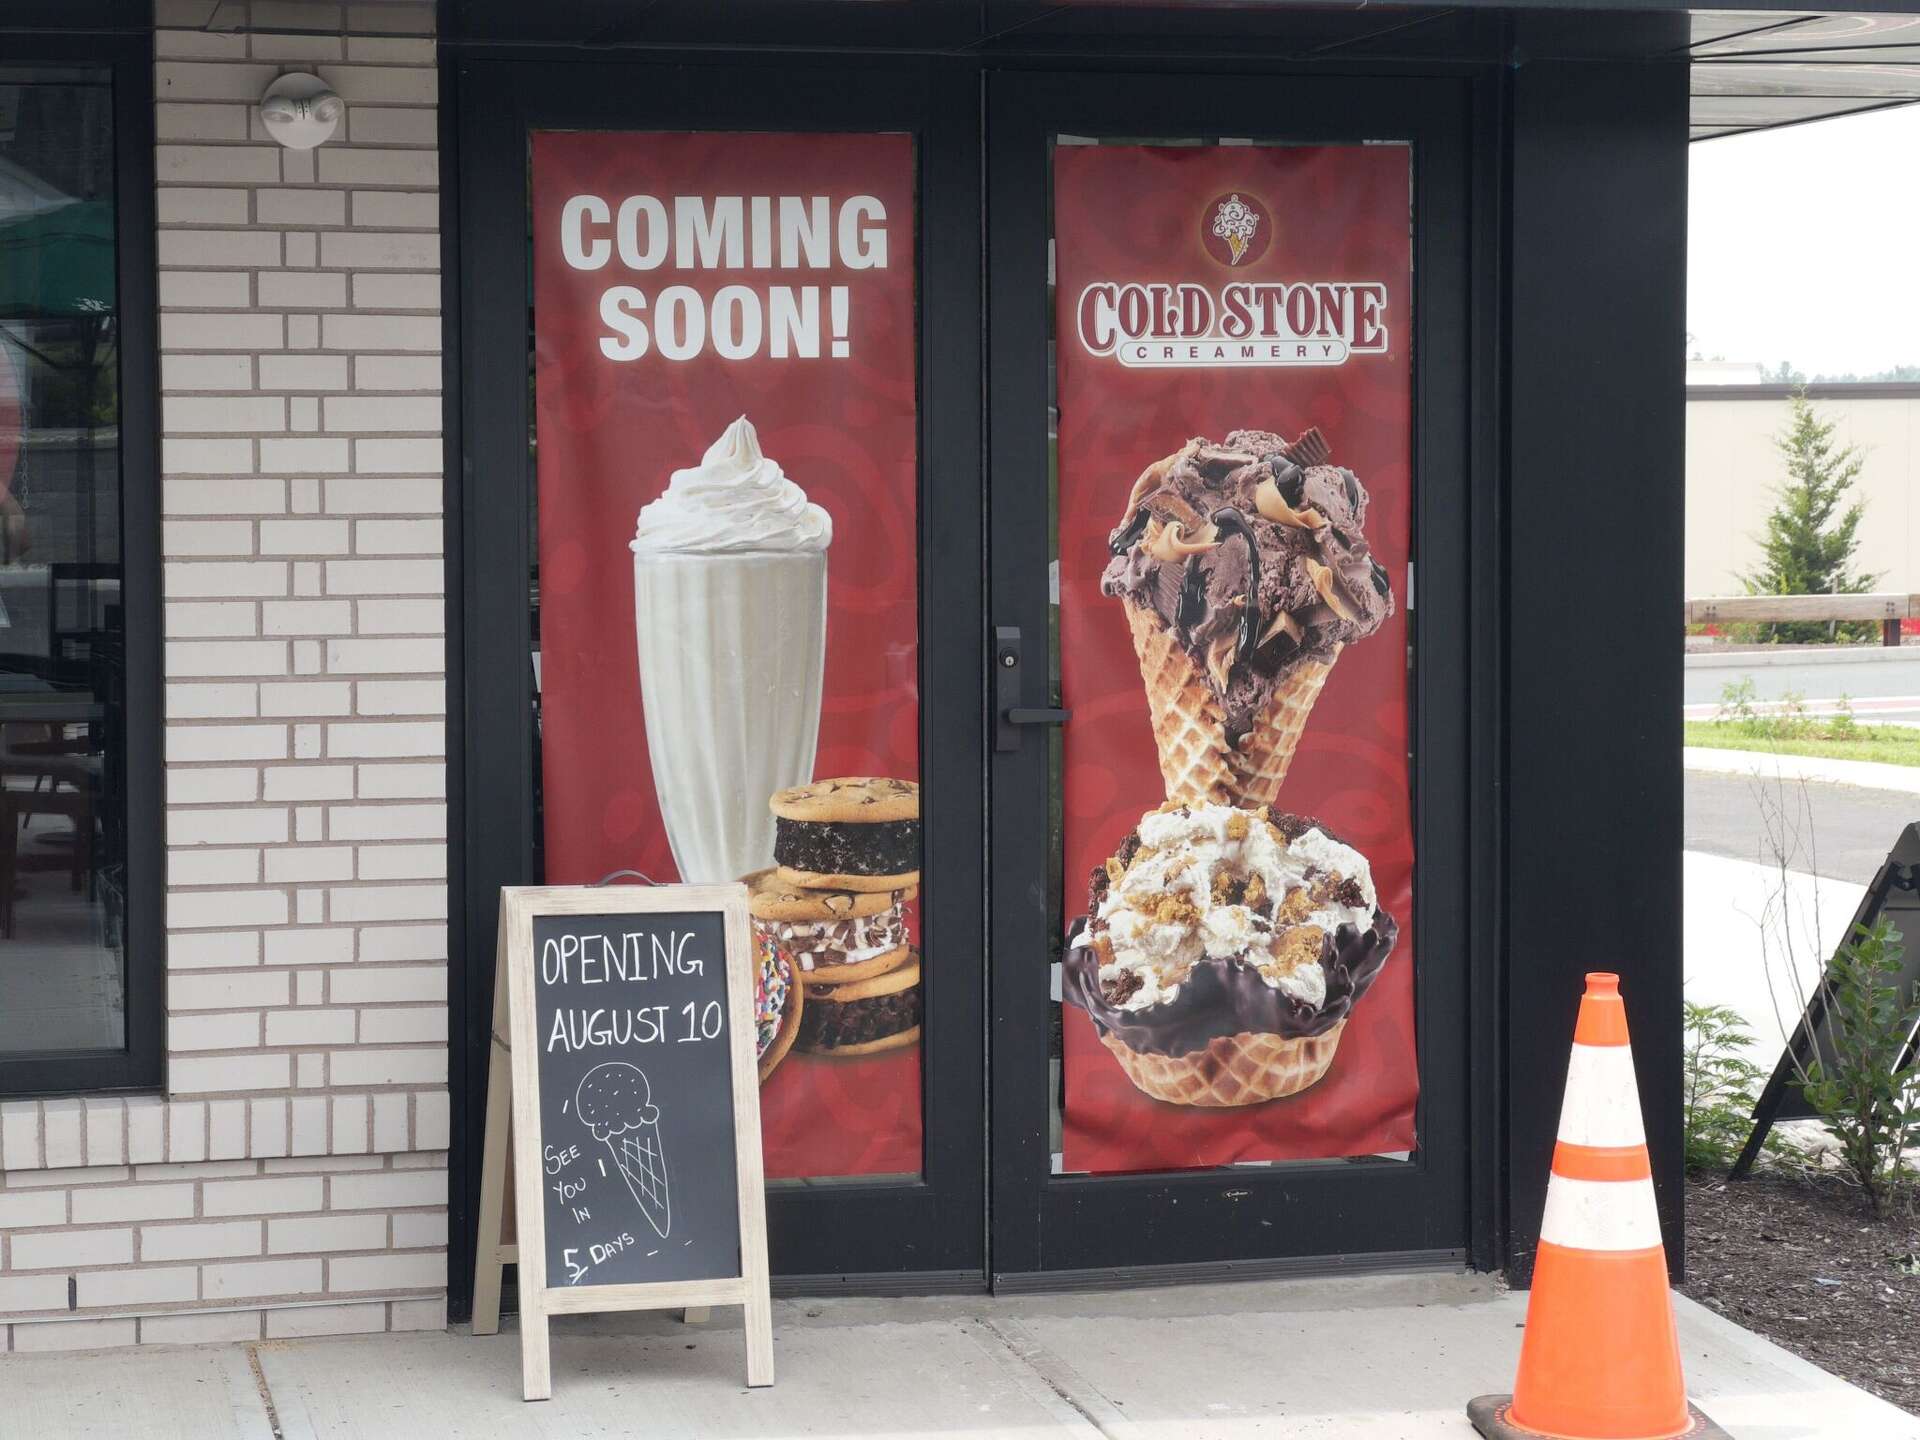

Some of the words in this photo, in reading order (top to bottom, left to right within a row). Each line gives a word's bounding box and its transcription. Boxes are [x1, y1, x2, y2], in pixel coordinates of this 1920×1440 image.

[561, 195, 888, 270] COMING
[599, 285, 850, 361] SOON!
[1078, 283, 1214, 356] COLD
[1220, 282, 1387, 353] STONE
[1136, 345, 1332, 359] CREAMERY
[542, 931, 703, 985] OPENING
[547, 1006, 669, 1053] AUGUST
[677, 1001, 722, 1043] 10
[563, 1248, 584, 1281] 5
